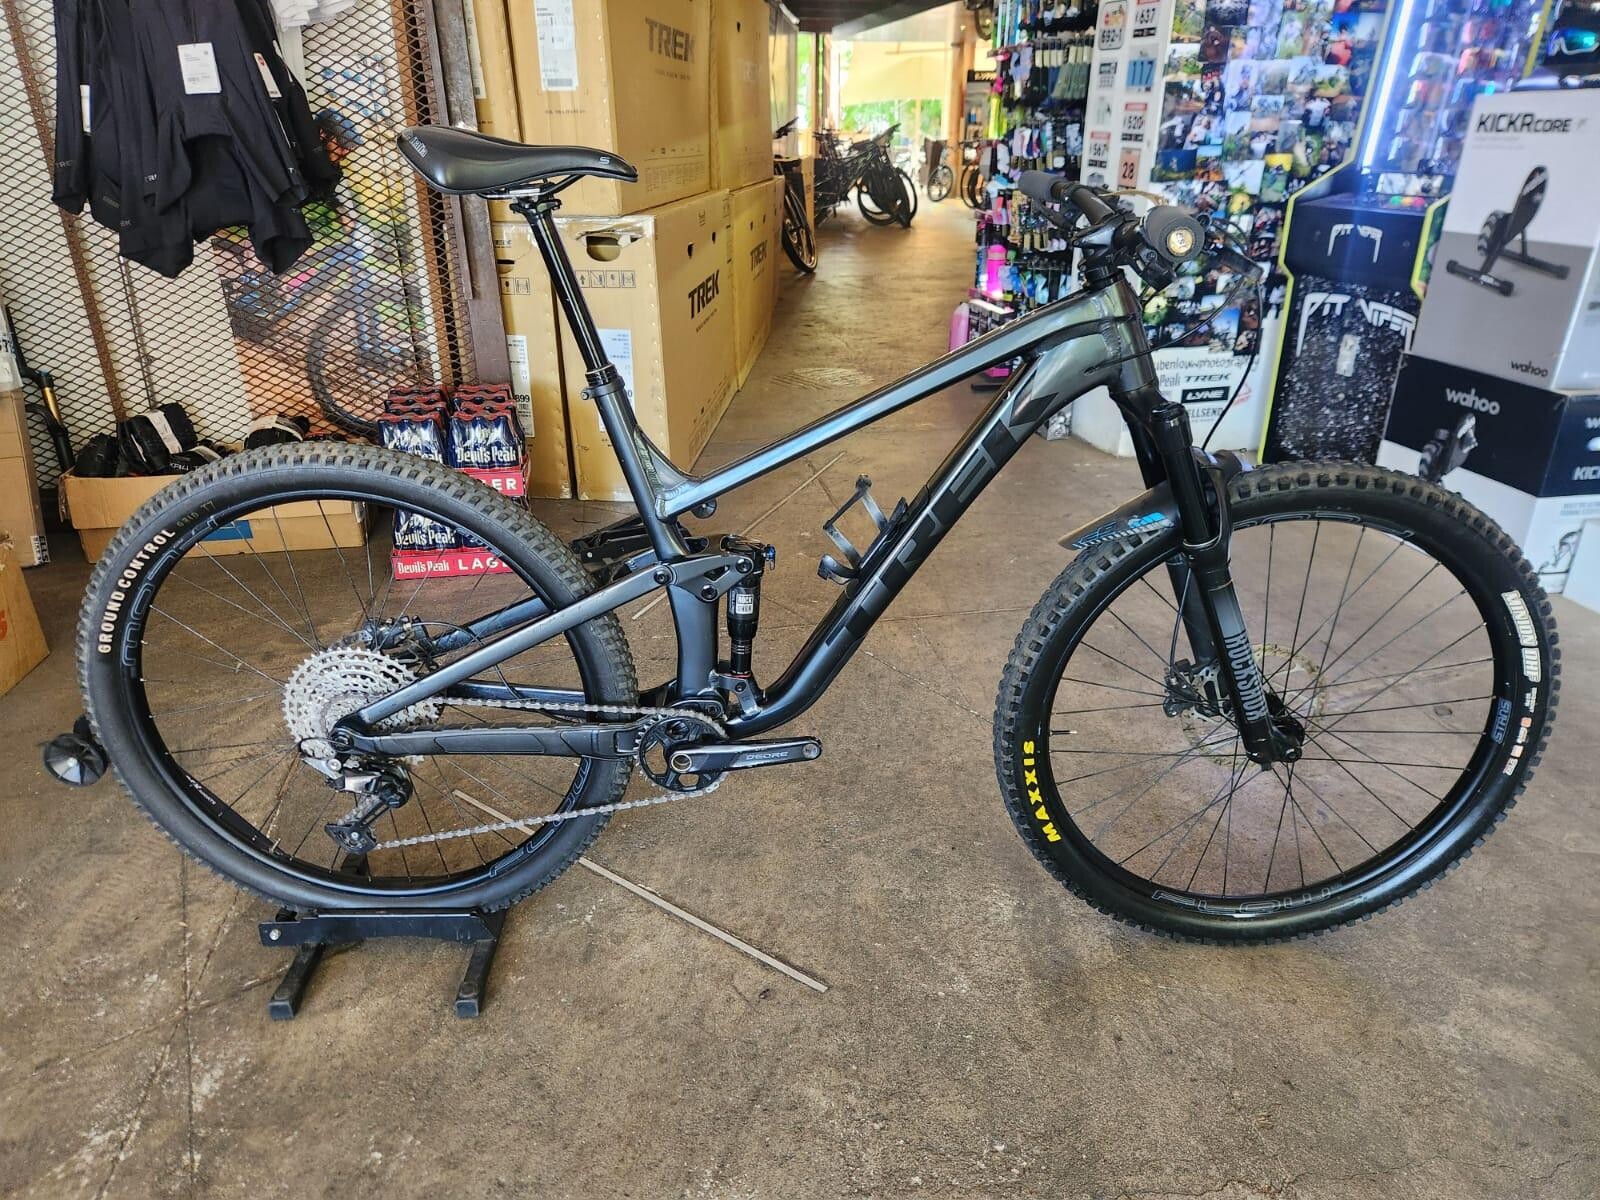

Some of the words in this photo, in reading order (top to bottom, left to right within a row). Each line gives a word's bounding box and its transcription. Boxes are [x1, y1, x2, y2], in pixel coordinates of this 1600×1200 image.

[645, 17, 694, 63] TREK
[1121, 161, 1136, 180] 28
[688, 269, 720, 319] TREK
[1296, 292, 1351, 357] PIT
[1359, 298, 1417, 352] VIPER
[1184, 373, 1231, 383] TREK
[1510, 359, 1549, 378] wahoo
[1186, 389, 1225, 401] LYNE
[1445, 388, 1500, 416] wahoo
[456, 447, 489, 463] Devil's
[492, 445, 517, 463] Peak
[397, 561, 427, 574] Devil's
[427, 560, 450, 573] Peak
[98, 590, 126, 654] GROUND
[117, 528, 176, 590] CONTROL
[1223, 631, 1268, 721] ROCKSHOX
[746, 751, 789, 760] DEORE
[1023, 740, 1062, 842] MAXXIS
